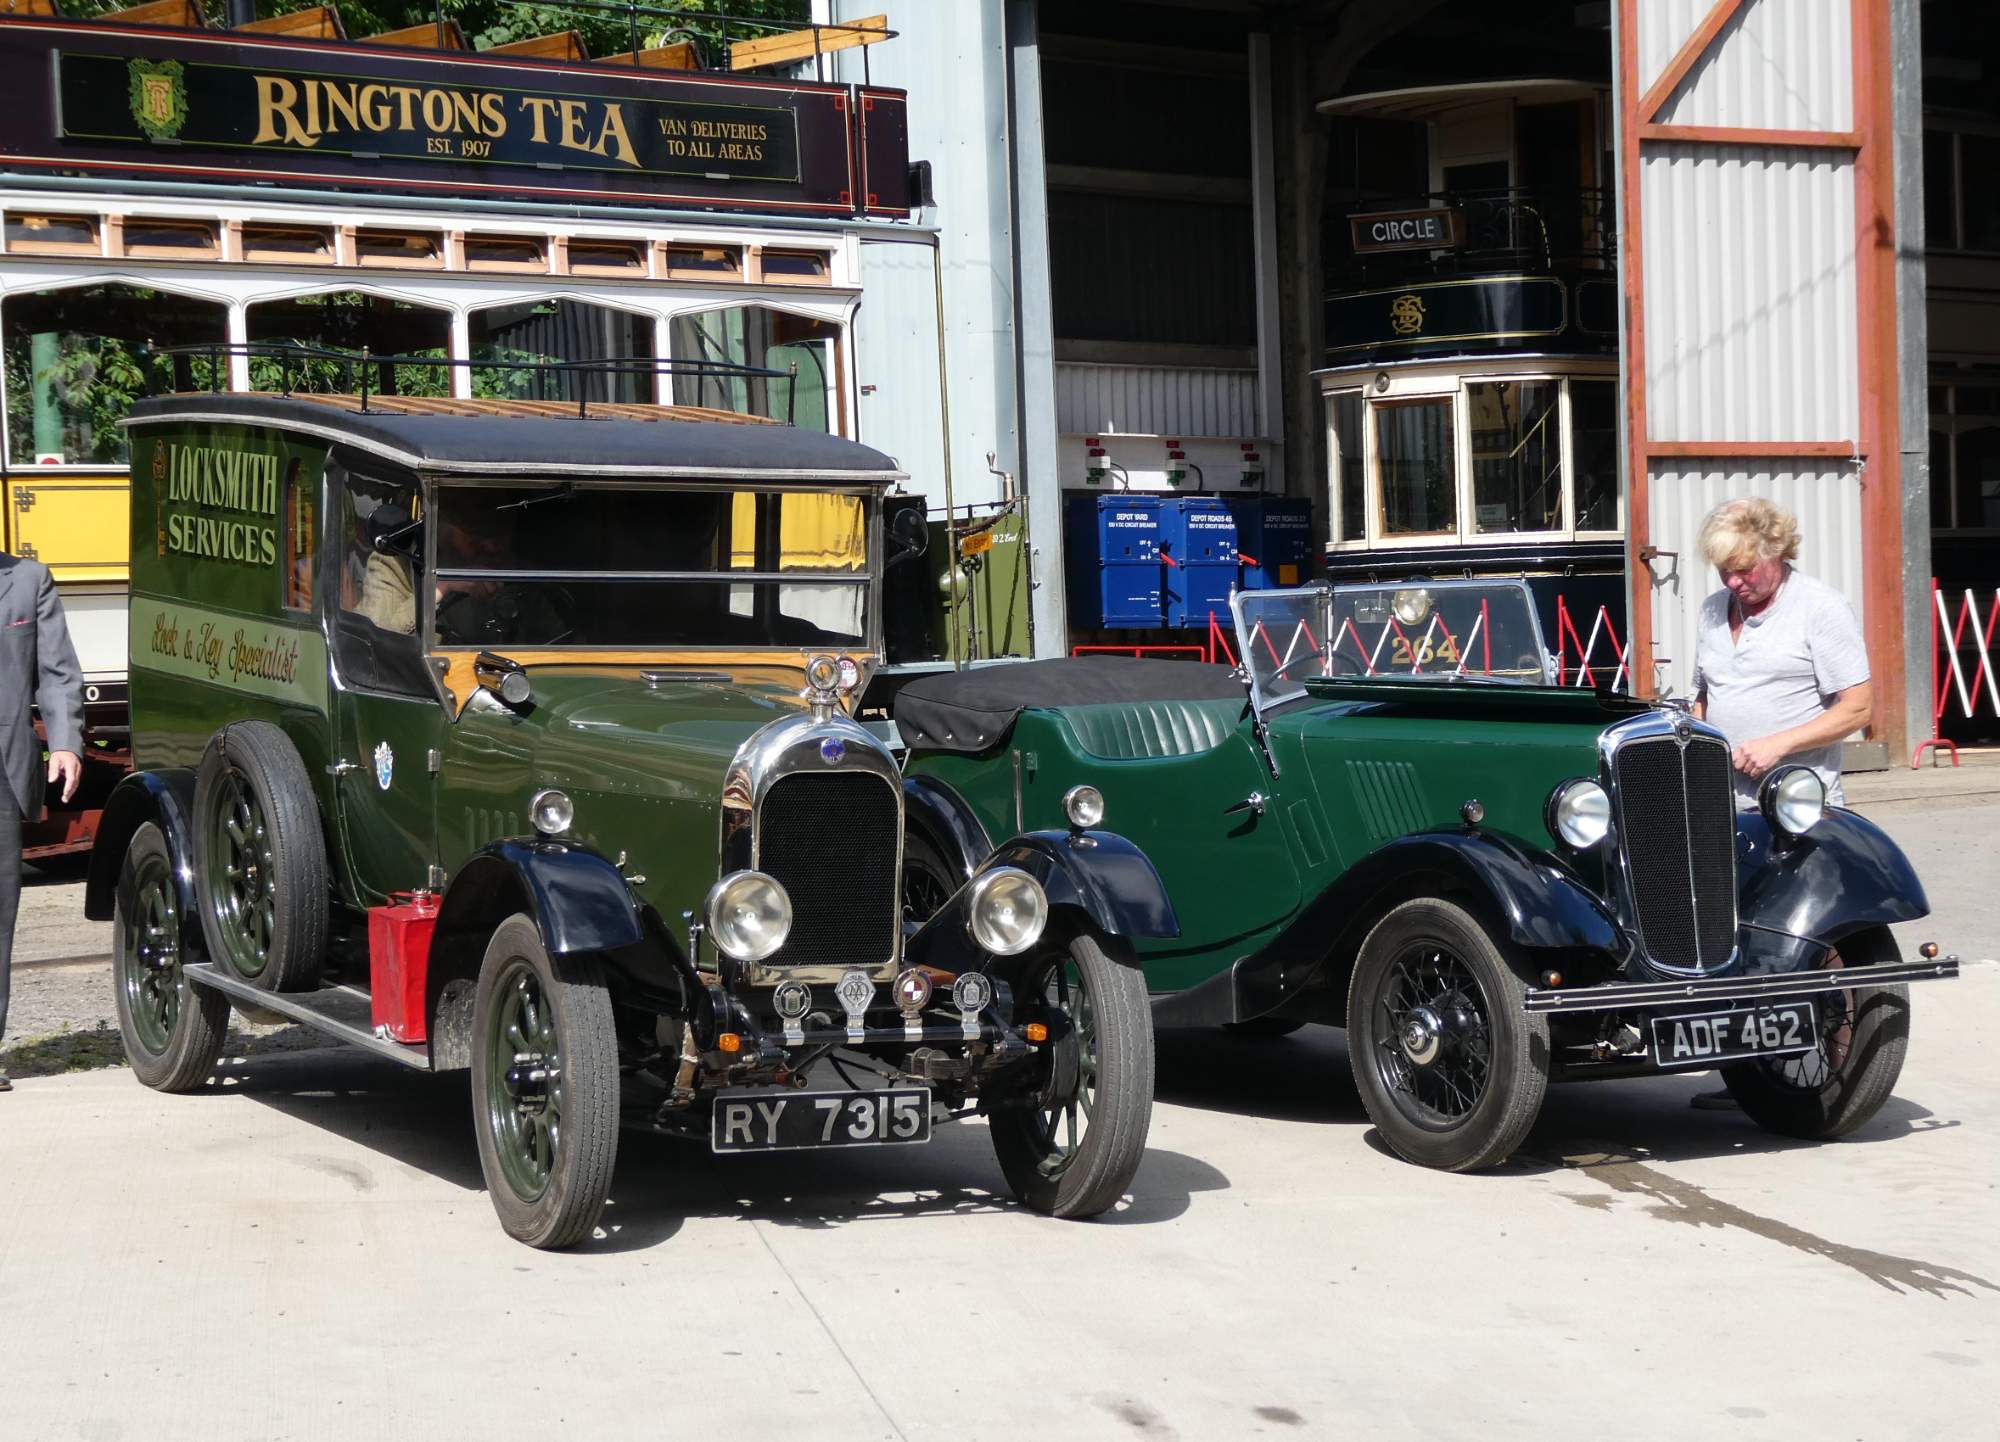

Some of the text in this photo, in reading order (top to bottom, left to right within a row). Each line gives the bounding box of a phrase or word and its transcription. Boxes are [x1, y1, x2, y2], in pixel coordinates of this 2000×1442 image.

[252, 75, 507, 147] RINGTONS
[519, 96, 643, 168] TEA
[659, 119, 767, 141] VAN DELIVERIES
[427, 138, 492, 158] EST. 1907
[667, 140, 763, 160] TO ALL AREAS
[1372, 219, 1435, 241] CIRCLE
[169, 444, 278, 515] LOCKSMITH
[1116, 513, 1133, 521] DEPOT
[169, 514, 276, 566] SERVICES
[151, 612, 298, 685] Lock & Key Specialist
[1391, 635, 1459, 665] 264
[1674, 1010, 1803, 1058] ADF 462
[725, 1095, 921, 1144] RY 7315
